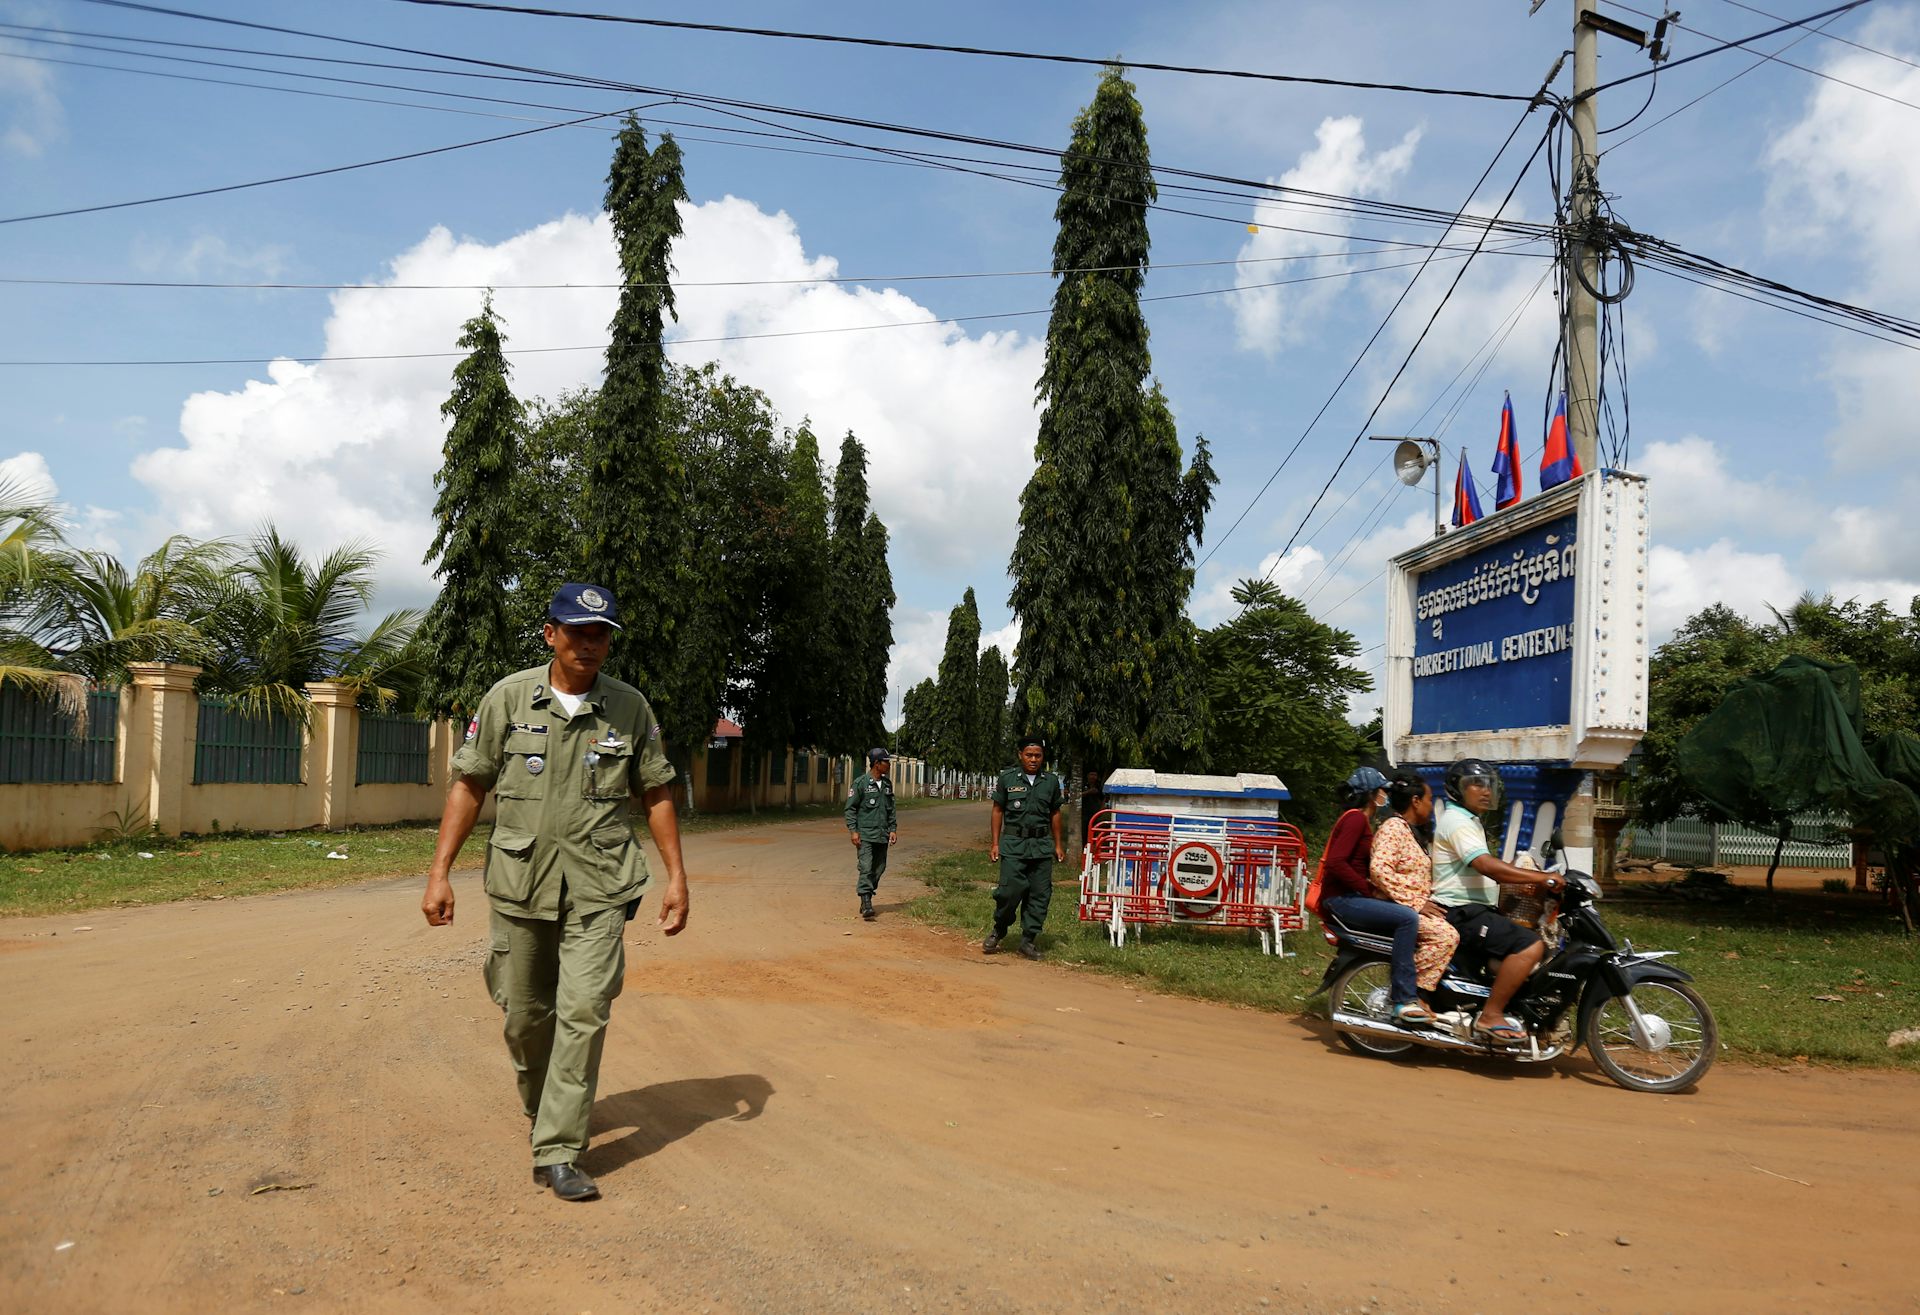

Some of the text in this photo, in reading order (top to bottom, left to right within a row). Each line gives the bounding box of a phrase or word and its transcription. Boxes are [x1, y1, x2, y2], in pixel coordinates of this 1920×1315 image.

[1414, 640, 1499, 678] CORRECTIONAL
[1502, 627, 1555, 661] CENTER
[1548, 971, 1577, 980] HONDA
